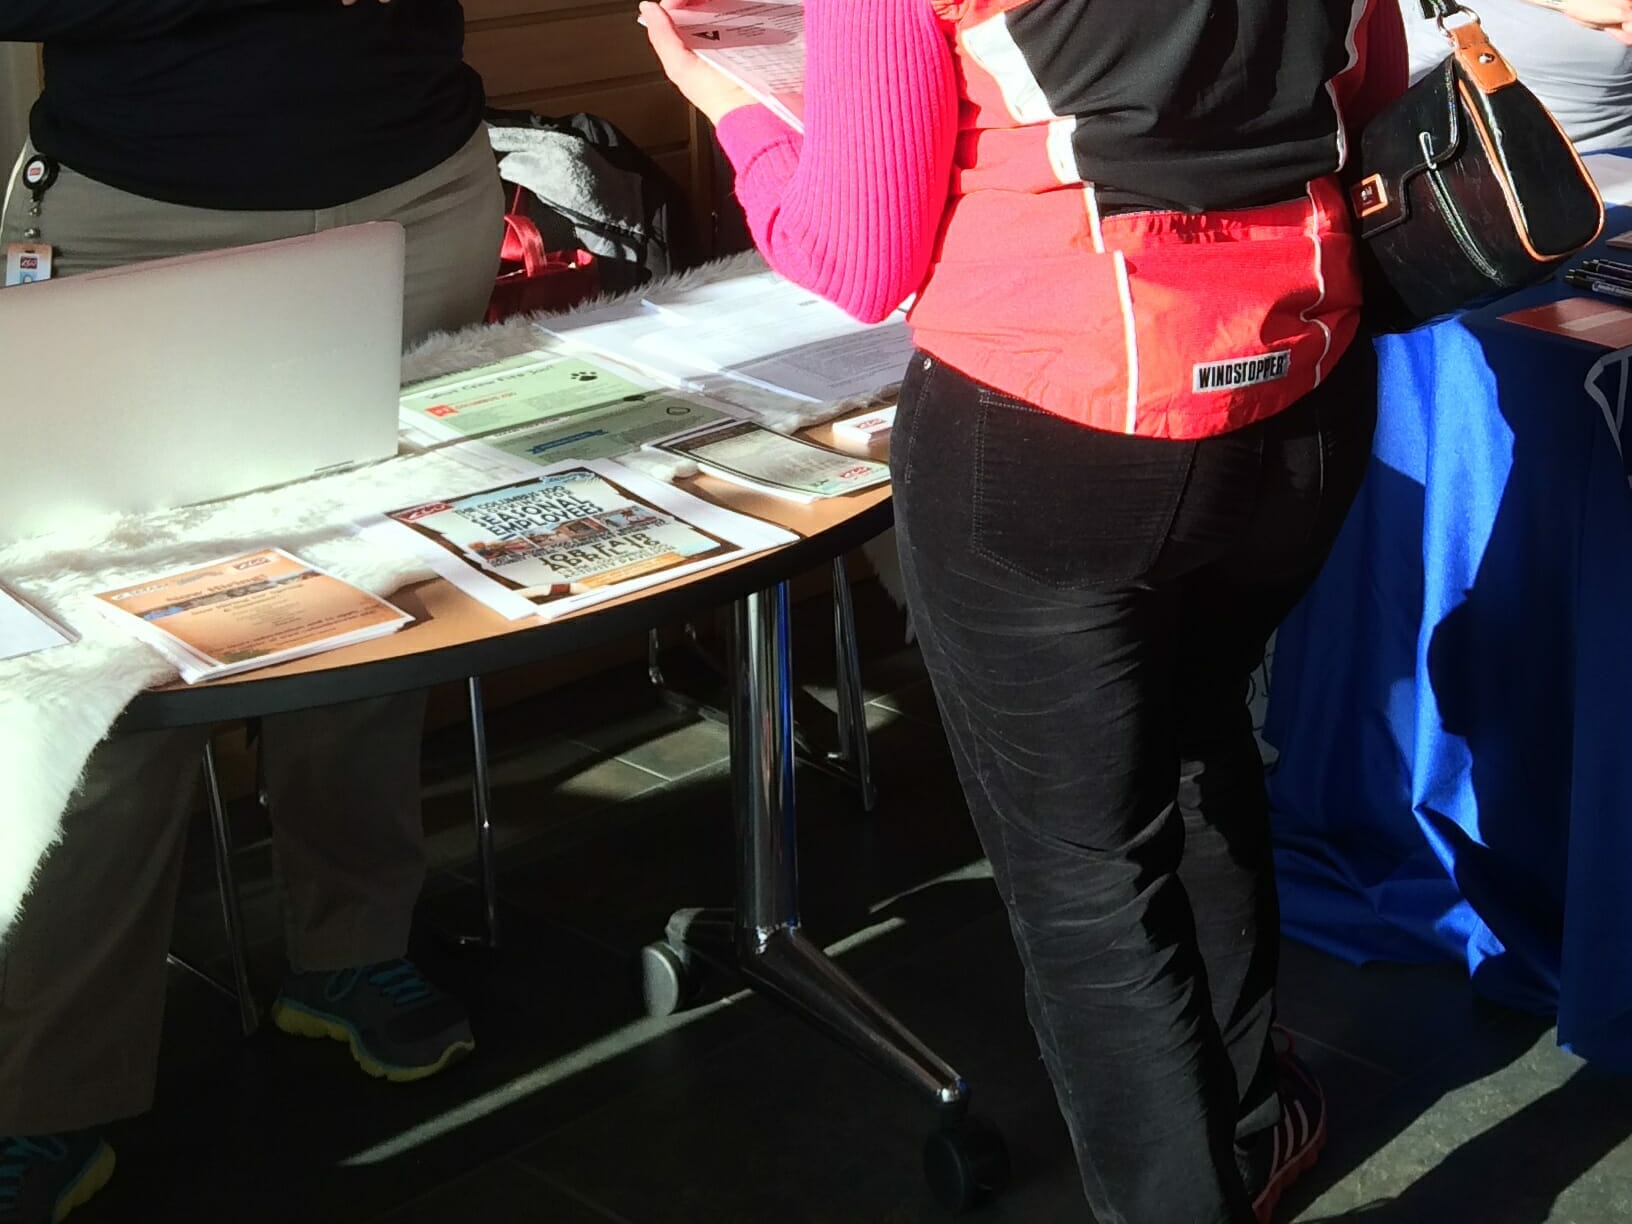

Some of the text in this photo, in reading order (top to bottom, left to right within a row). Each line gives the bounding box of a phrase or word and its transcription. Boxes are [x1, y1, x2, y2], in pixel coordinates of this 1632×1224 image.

[1198, 355, 1284, 389] WINDSTOPPER
[471, 495, 590, 528] SEASONAL
[486, 503, 604, 537] EMPLOYEES
[538, 548, 586, 566] JOB
[591, 532, 650, 553] FAIR
[548, 547, 626, 572] APRIL
